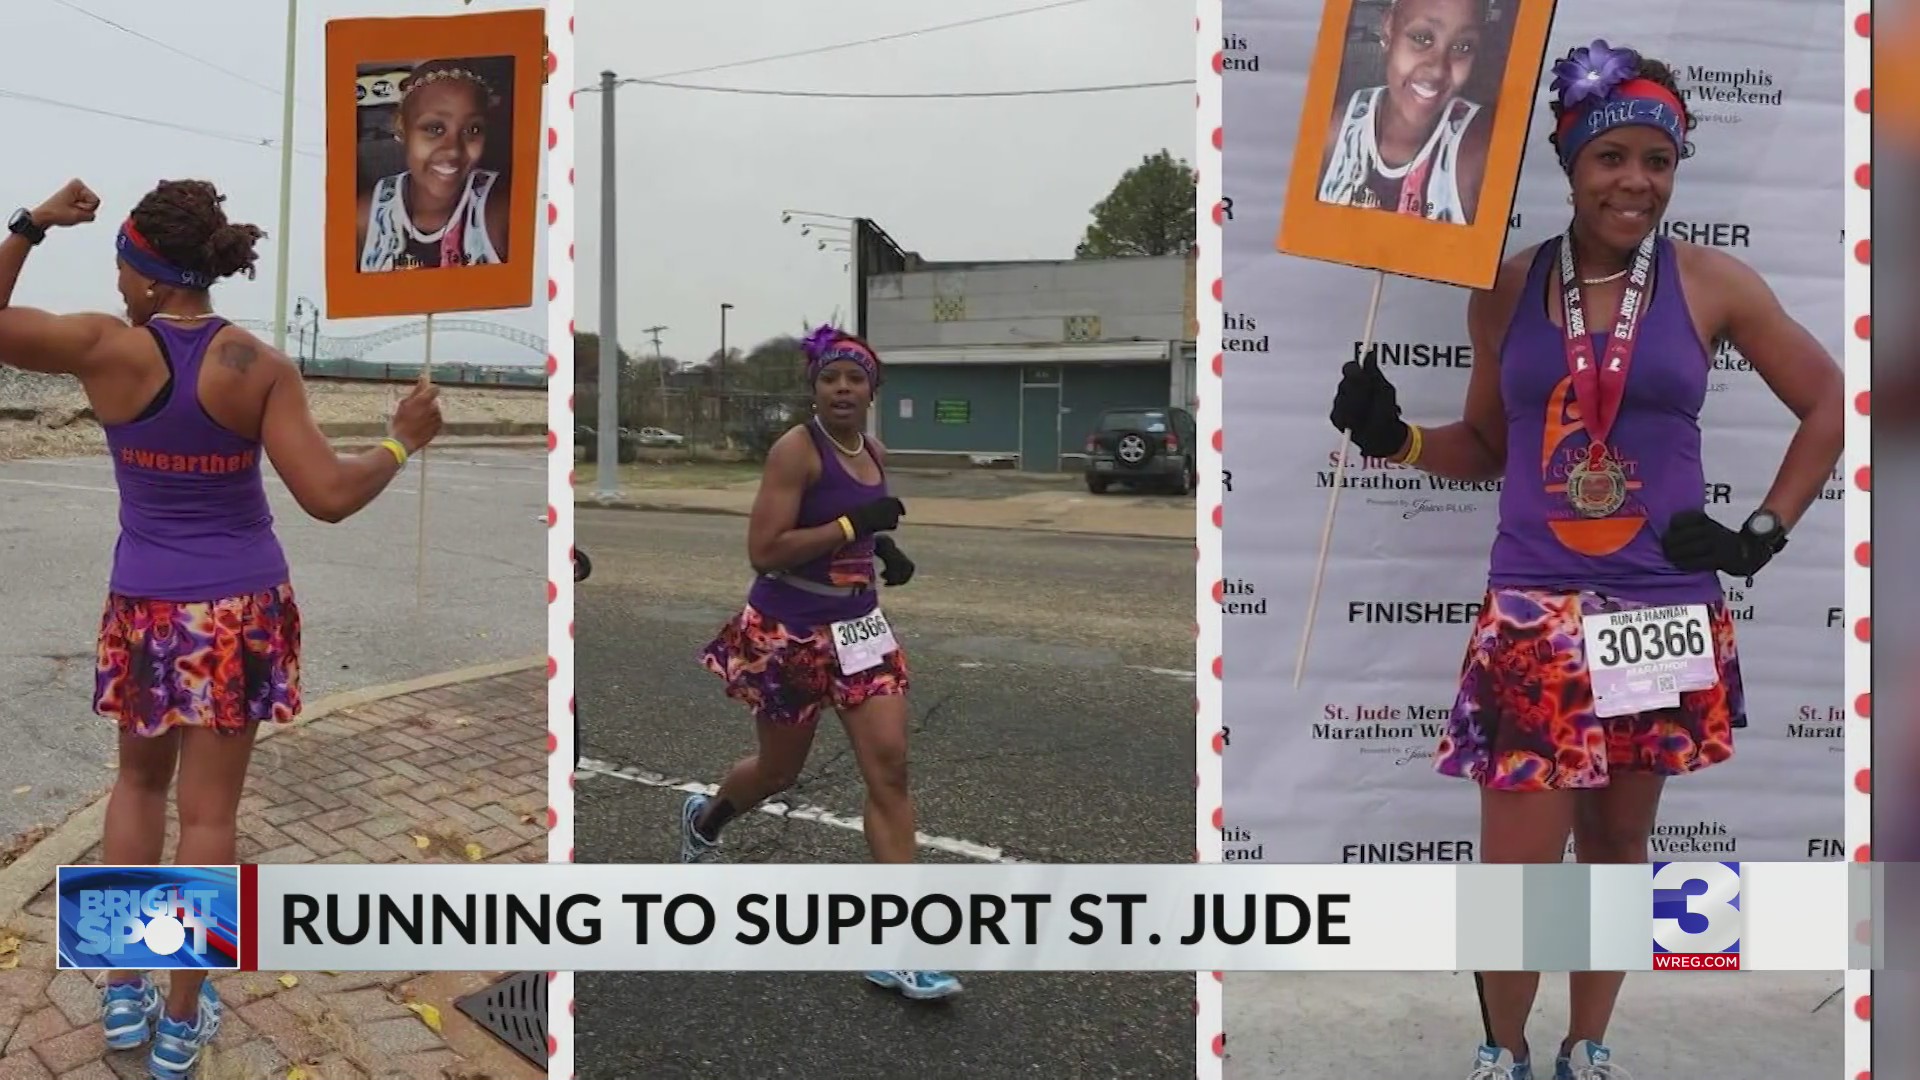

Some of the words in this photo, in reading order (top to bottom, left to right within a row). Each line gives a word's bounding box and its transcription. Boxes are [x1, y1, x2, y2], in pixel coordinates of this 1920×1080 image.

[1687, 66, 1773, 87] Memphis
[1699, 86, 1782, 106] Weekend
[1656, 221, 1750, 247] ISHER
[1354, 341, 1472, 368] FINISHE
[1349, 601, 1484, 624] FINISHER
[1610, 614, 1633, 626] RUN
[1644, 606, 1689, 621] HANNAH
[838, 616, 887, 646] 30366
[1598, 619, 1704, 666] 30366
[1324, 703, 1349, 720] St.
[1355, 705, 1400, 722] Jude
[1799, 705, 1822, 721] St.
[1312, 723, 1410, 740] Marathon
[1786, 724, 1845, 738] Marat
[1342, 841, 1474, 864] FINISHER
[1651, 838, 1736, 854] Weekend
